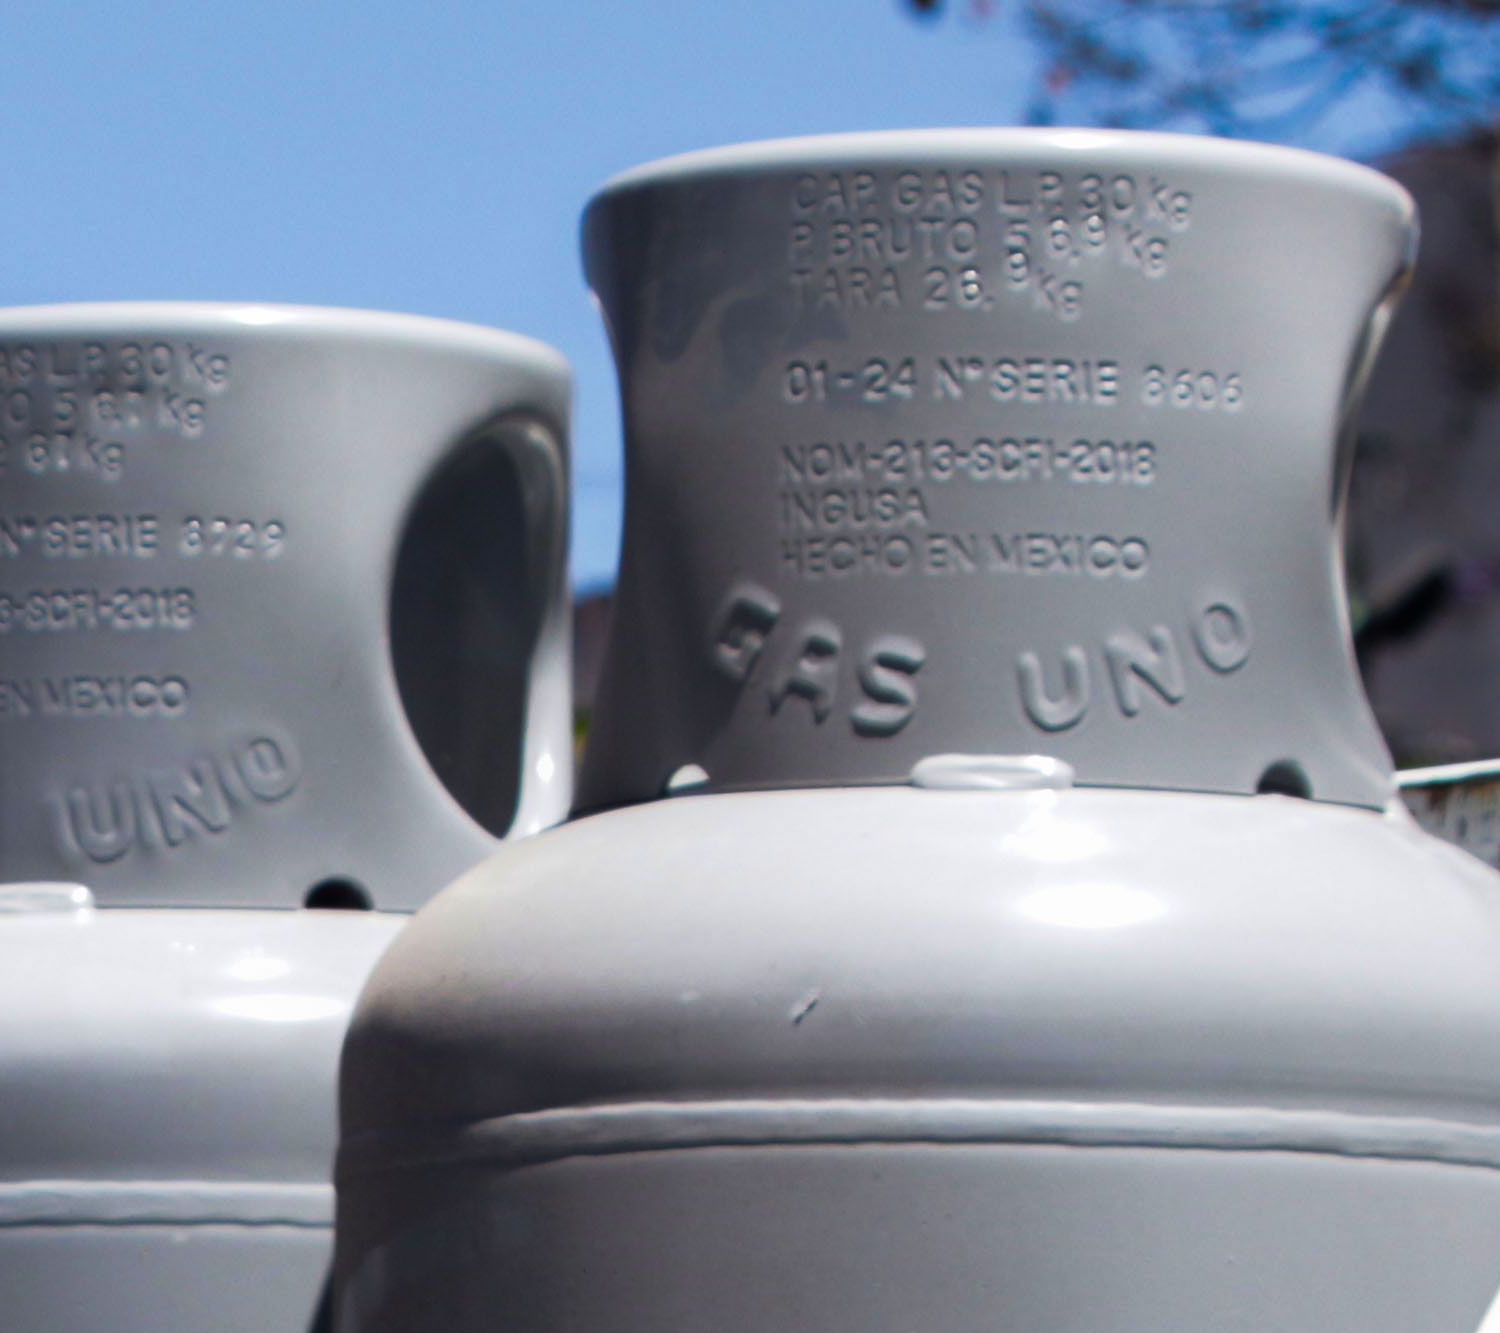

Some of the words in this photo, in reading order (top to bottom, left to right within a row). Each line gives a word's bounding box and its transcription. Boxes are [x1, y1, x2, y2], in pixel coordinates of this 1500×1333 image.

[897, 169, 985, 215] GAS
[1079, 172, 1137, 219] 30
[830, 217, 979, 261] BRUTO
[791, 266, 900, 308] TARA
[117, 341, 173, 386] 30
[783, 356, 917, 403] 01-24
[990, 357, 1118, 405] SERIE
[781, 486, 929, 530] INGUSA
[41, 513, 160, 560] SERIE
[781, 533, 912, 576] HECHO
[924, 533, 976, 574] EN
[988, 532, 1150, 577] MEXICO
[713, 578, 927, 739] GAS
[1016, 594, 1253, 734] UNO
[53, 734, 299, 865] UNO
